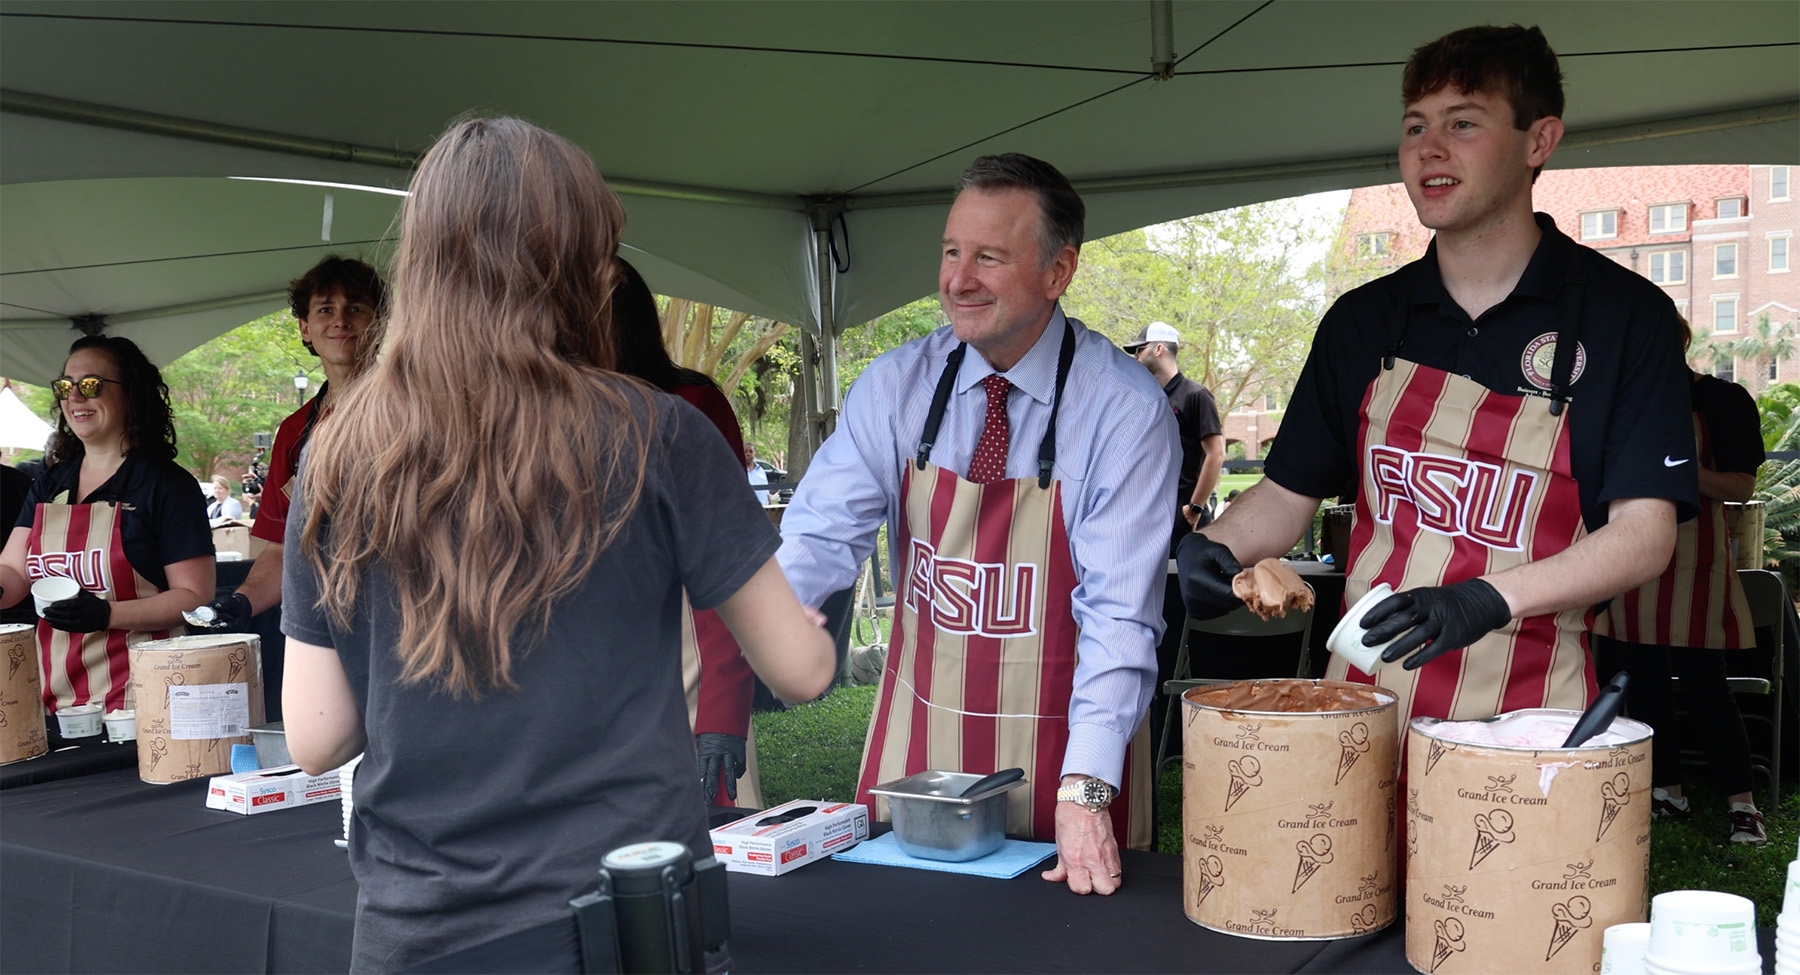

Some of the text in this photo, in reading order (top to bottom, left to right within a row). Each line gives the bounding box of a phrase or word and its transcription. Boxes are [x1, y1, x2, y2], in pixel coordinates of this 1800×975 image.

[1524, 339, 1542, 376] FLORIDA
[1541, 335, 1558, 343] STA
[1369, 445, 1539, 551] FSU
[26, 549, 110, 594] FSU
[905, 538, 1037, 638] FSU
[1214, 737, 1290, 752] Grand Ice Cream
[1615, 757, 1626, 767] Ice
[1627, 752, 1646, 764] Cream
[260, 786, 276, 795] Sysco
[1457, 788, 1548, 805] Grand Ice Cream
[257, 795, 280, 805] Classic
[1416, 808, 1434, 823] Cream
[1278, 818, 1358, 829] Grand Ice Cream
[786, 839, 800, 848] Sysco
[1189, 834, 1248, 856] Grand Ice Cream
[785, 847, 803, 862] Classic
[1531, 877, 1617, 890] Grand Ice Cream
[1335, 892, 1362, 904] Grand
[1363, 890, 1374, 900] Ice
[1423, 893, 1495, 919] Grand Ice Cream
[1226, 920, 1304, 936] Grand Ice Cream
